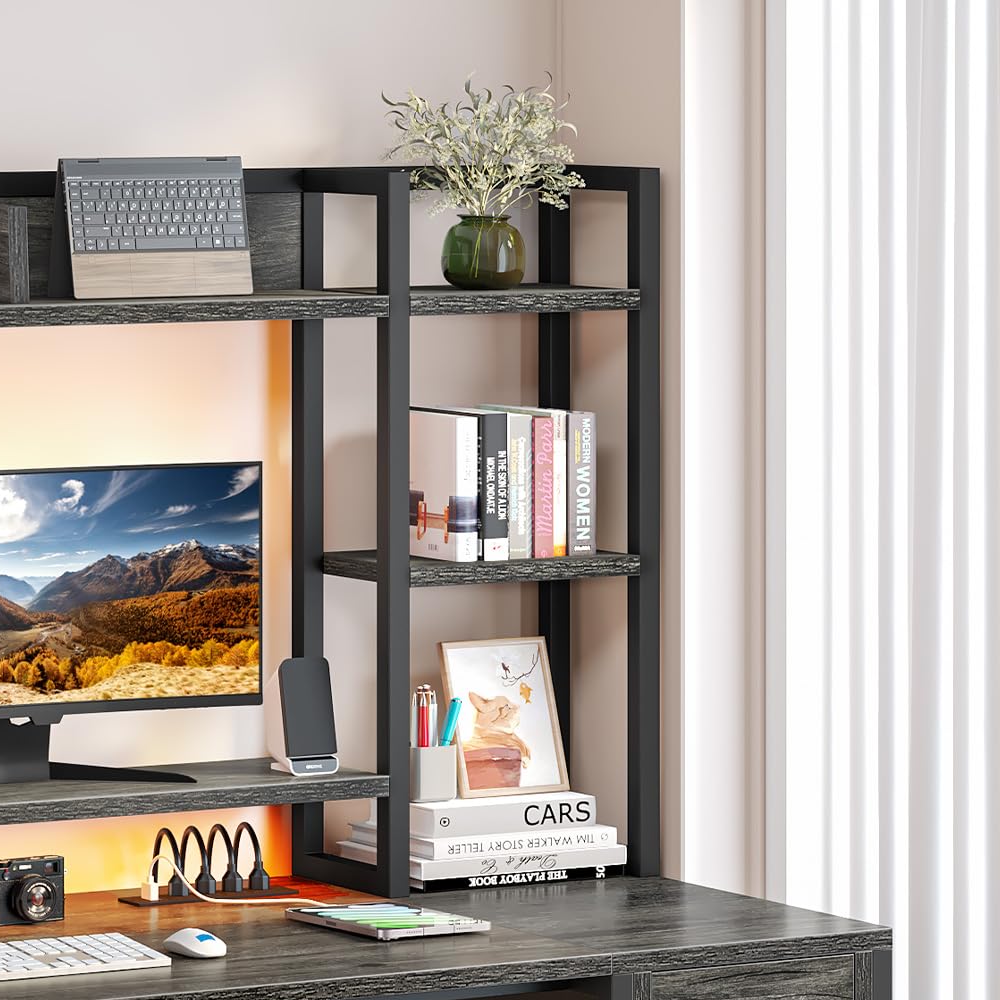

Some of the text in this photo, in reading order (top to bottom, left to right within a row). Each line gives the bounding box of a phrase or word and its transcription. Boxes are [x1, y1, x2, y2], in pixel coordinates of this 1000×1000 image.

[582, 418, 591, 463] MODERN
[486, 456, 496, 483] MICHAEL
[497, 458, 507, 472] THE
[535, 420, 553, 536] Martin Parr
[497, 488, 507, 498] OF
[576, 465, 591, 540] WOMEN
[497, 504, 507, 520] LION
[524, 802, 590, 825] CARS
[447, 831, 594, 855] TIM WALKER STORY TELLER
[517, 854, 558, 869] Death
[467, 870, 568, 887] THE PLAYBOY BOOK
